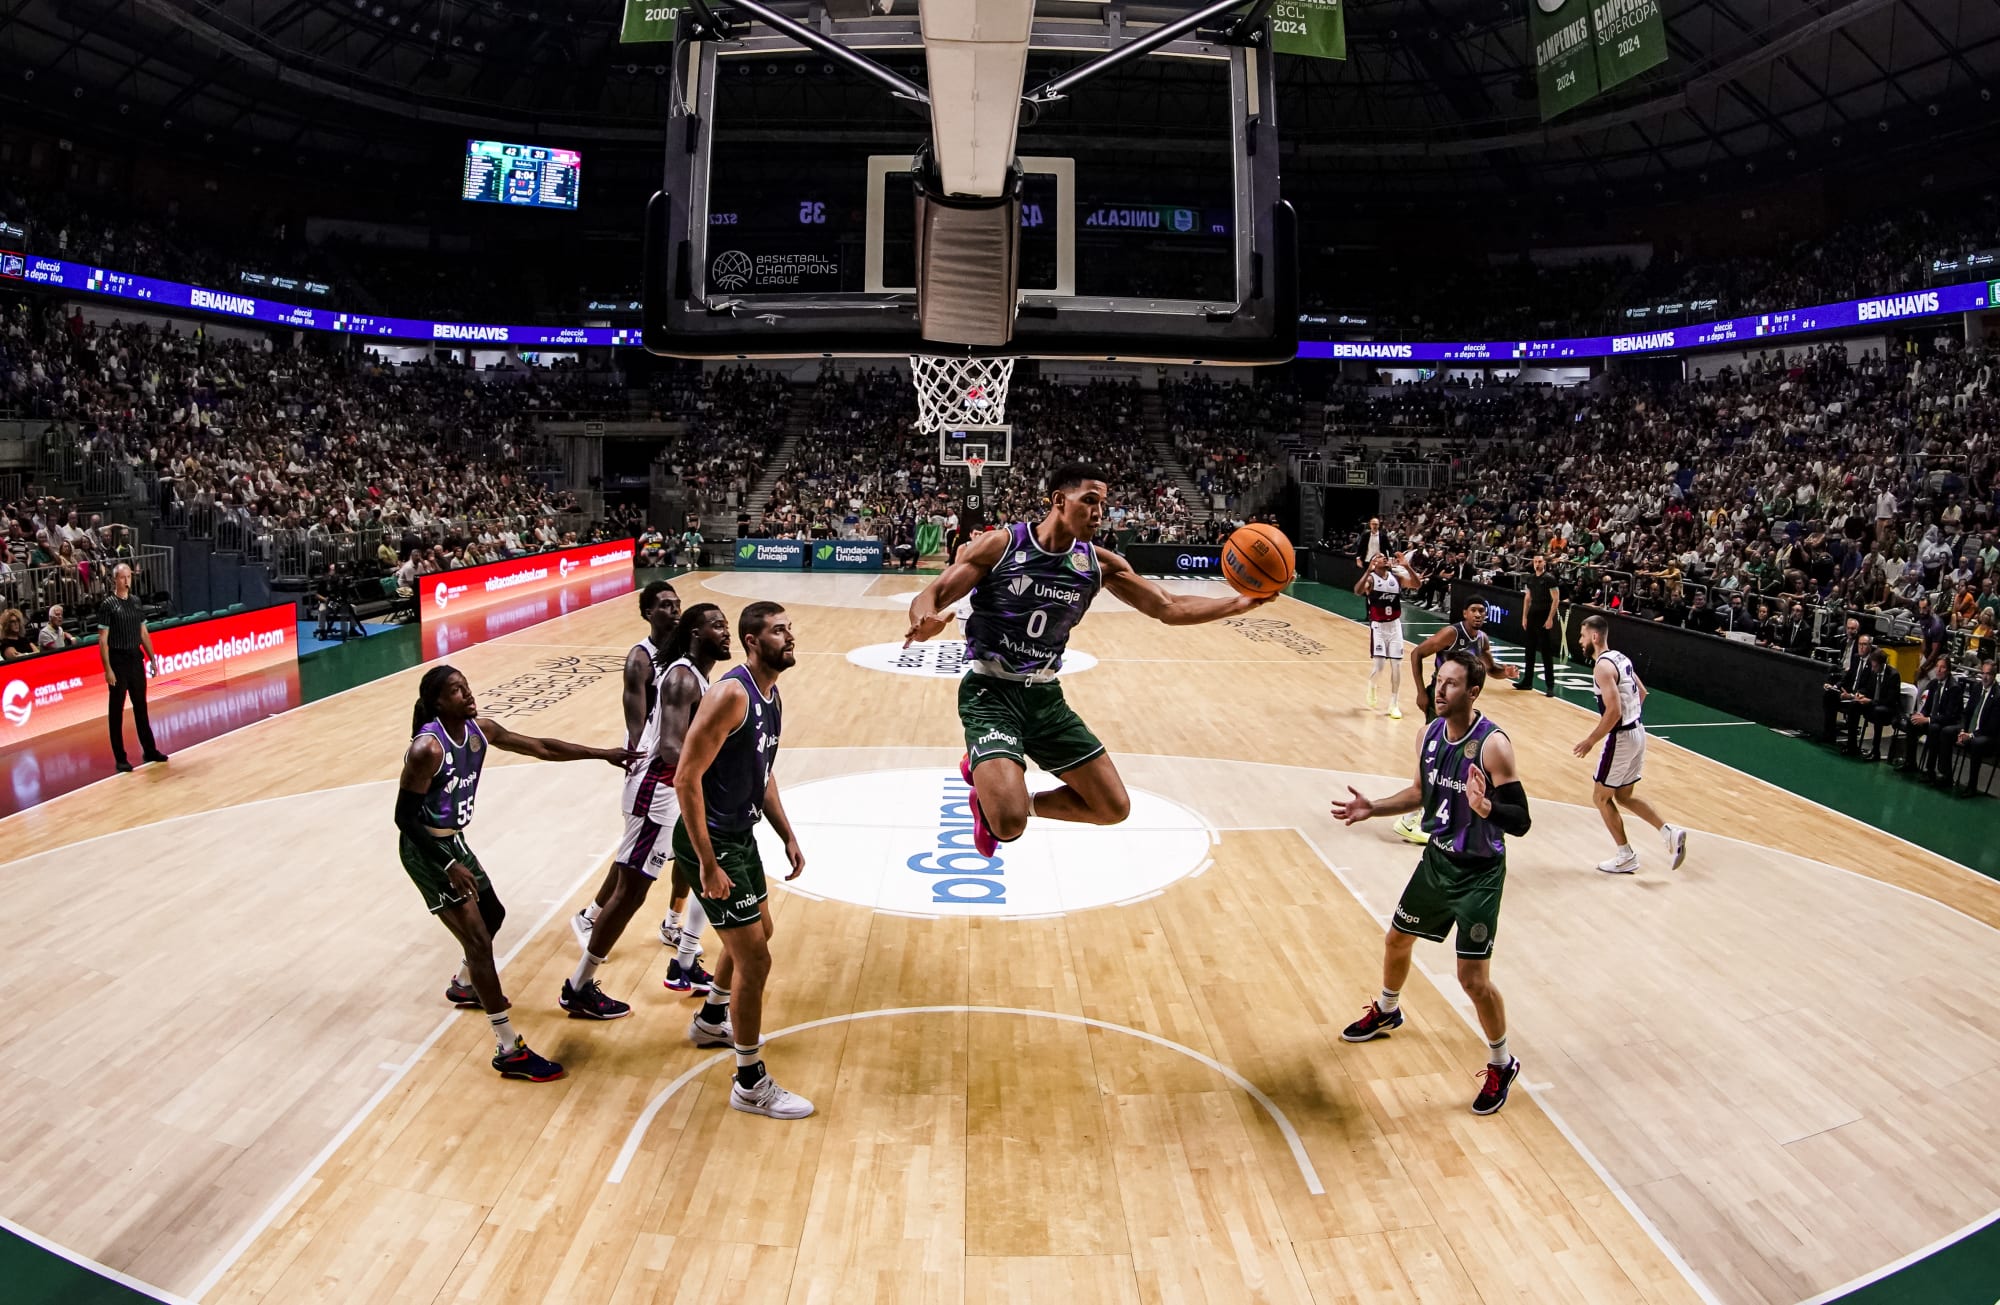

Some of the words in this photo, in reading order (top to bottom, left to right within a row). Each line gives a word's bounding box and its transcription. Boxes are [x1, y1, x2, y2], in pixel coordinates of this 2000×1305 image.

[645, 8, 679, 21] 2000
[1276, 5, 1305, 19] BCL
[1273, 20, 1308, 35] 2024
[1598, 1, 1658, 46] SUPERCOPA
[1537, 16, 1588, 66] CAMPEONES
[1618, 34, 1641, 57] 2024
[1556, 70, 1576, 91] 2024
[756, 254, 829, 264] BASKETBALL
[756, 264, 839, 275] CHAMPIONS
[755, 275, 800, 285] LEAGUE
[191, 289, 255, 316] BENAHAVIS
[1858, 292, 1939, 321] BENAHAVIS
[433, 324, 508, 341] BENAHAVIS
[1333, 344, 1412, 358] BENAHAVIS
[1612, 332, 1675, 352] BENAHAVIS
[757, 545, 800, 554] Fundación
[757, 553, 788, 562] Unicaja
[835, 546, 880, 555] Fundación
[835, 554, 868, 563] Unicaja
[1225, 549, 1263, 588] Wilson
[1034, 584, 1080, 604] Unicaja
[1385, 606, 1392, 616] 8
[1026, 610, 1048, 639] 0
[143, 627, 284, 679] stacostadelsol.com
[34, 684, 56, 698] COSTA
[56, 681, 68, 693] DEL
[69, 677, 83, 688] SOL
[35, 691, 63, 708] MÁLAGA
[457, 796, 474, 826] 55
[1435, 798, 1450, 825] 4
